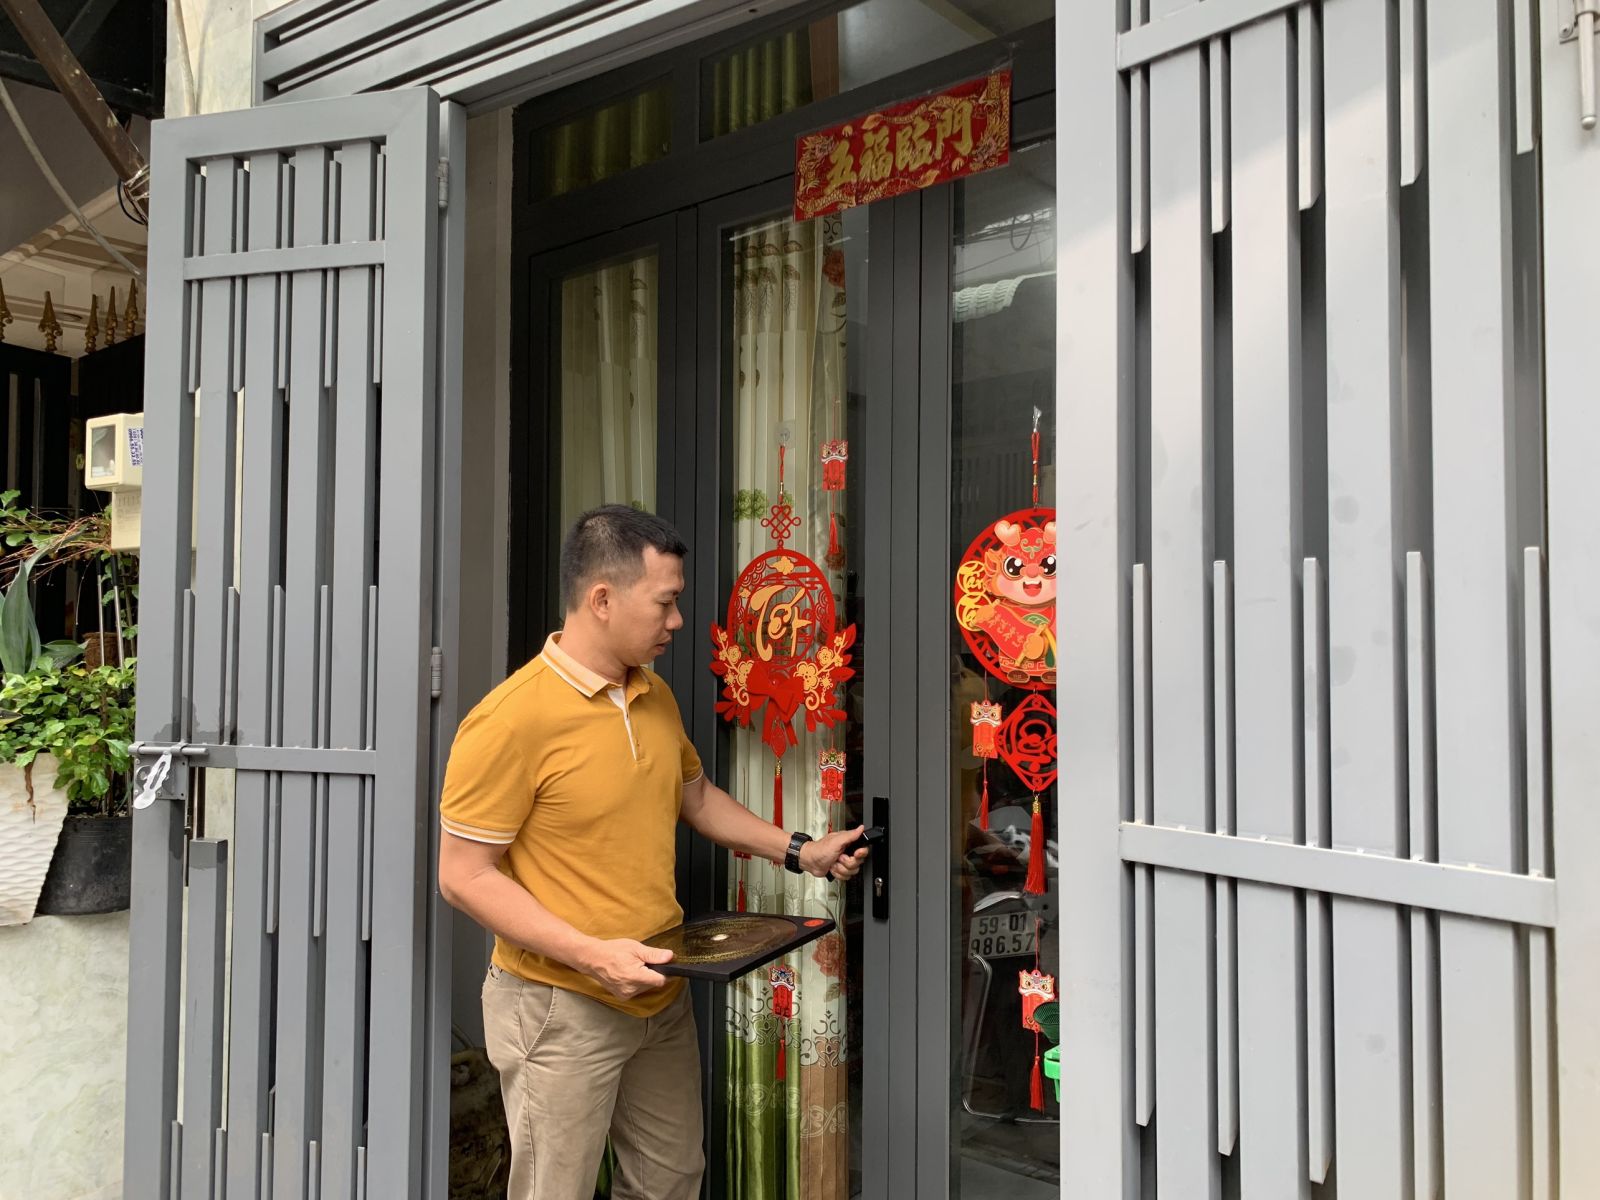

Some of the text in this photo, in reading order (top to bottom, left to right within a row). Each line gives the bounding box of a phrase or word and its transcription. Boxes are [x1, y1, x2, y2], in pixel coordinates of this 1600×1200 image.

[823, 101, 973, 195] 五福臨門
[750, 584, 812, 662] Tết
[971, 932, 1035, 955] 986.57
